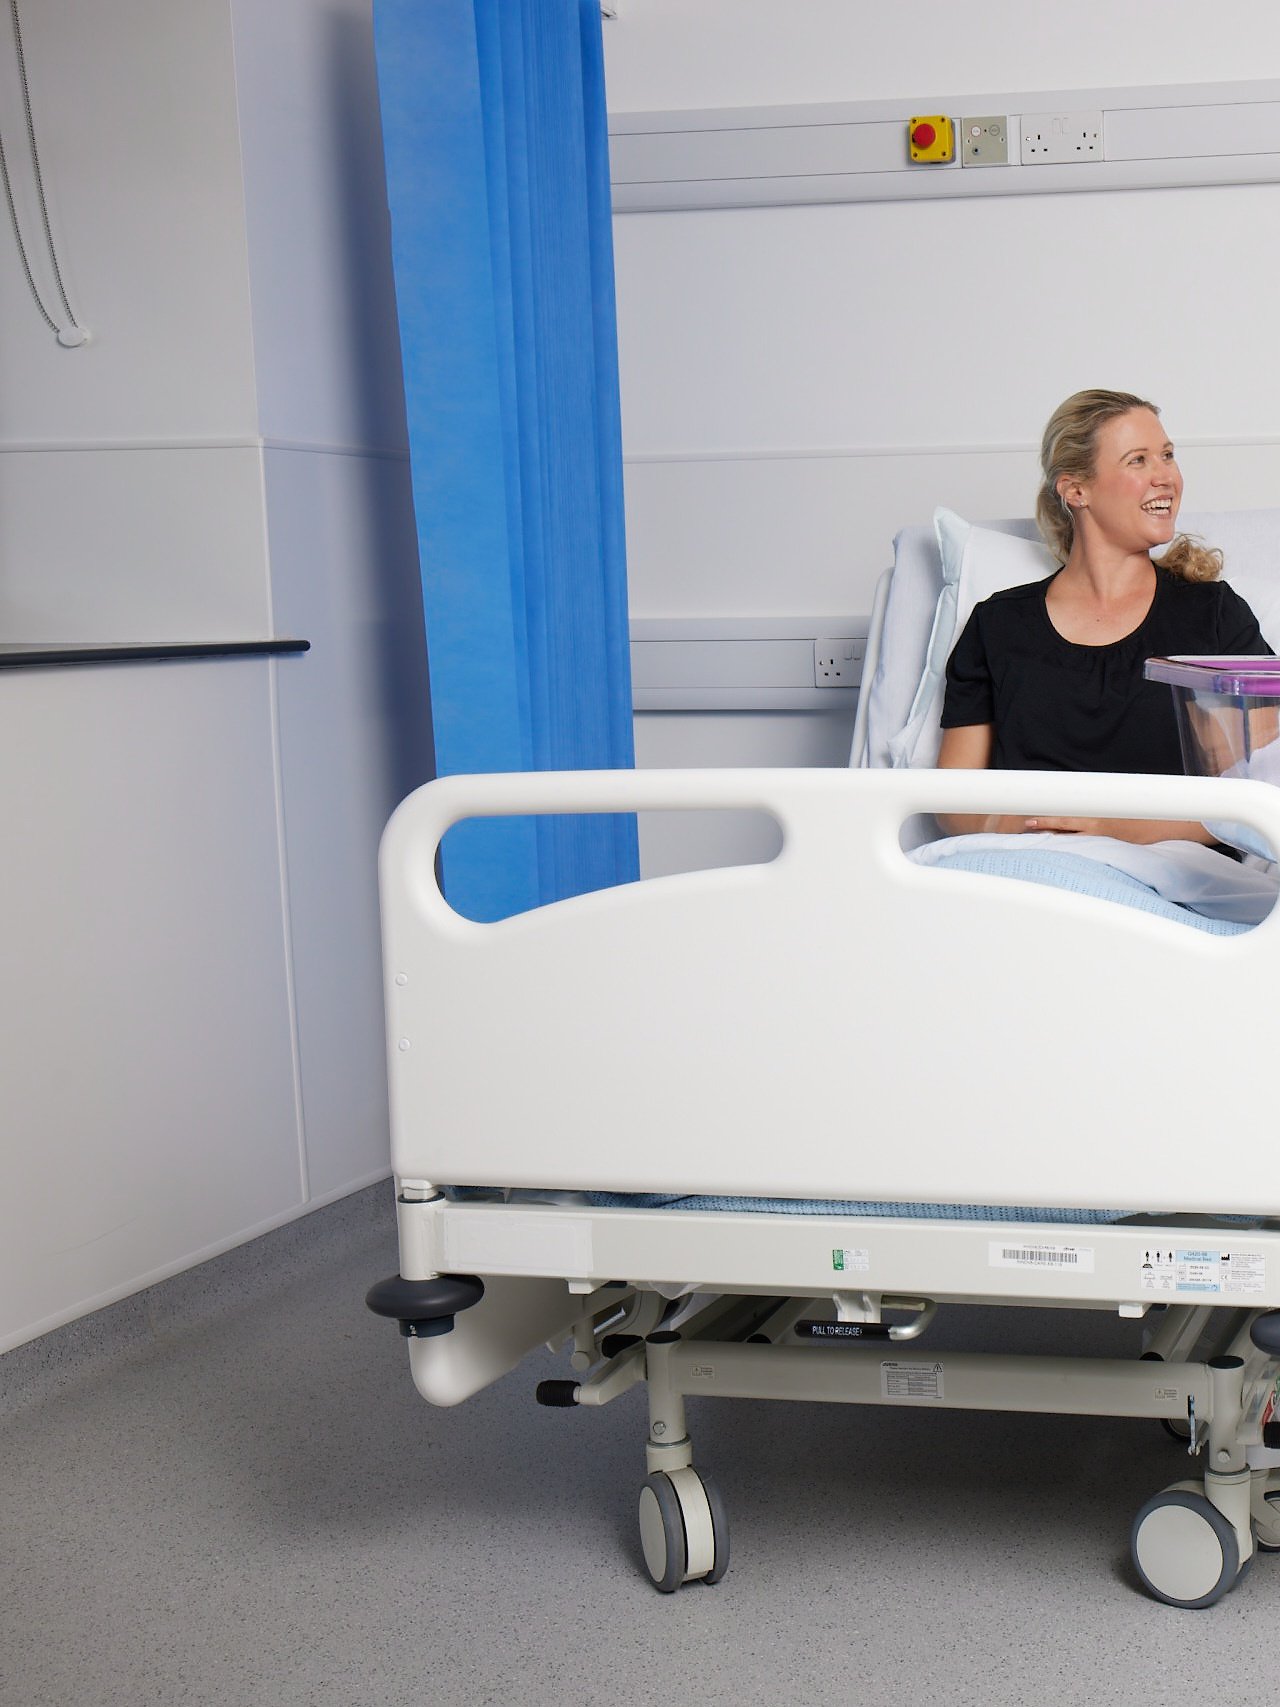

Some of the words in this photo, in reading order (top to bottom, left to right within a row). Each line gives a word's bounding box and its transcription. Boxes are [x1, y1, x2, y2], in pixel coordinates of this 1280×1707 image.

[812, 1326, 826, 1335] PULL
[826, 1326, 835, 1336] TO
[835, 1326, 860, 1336] RELEASE
